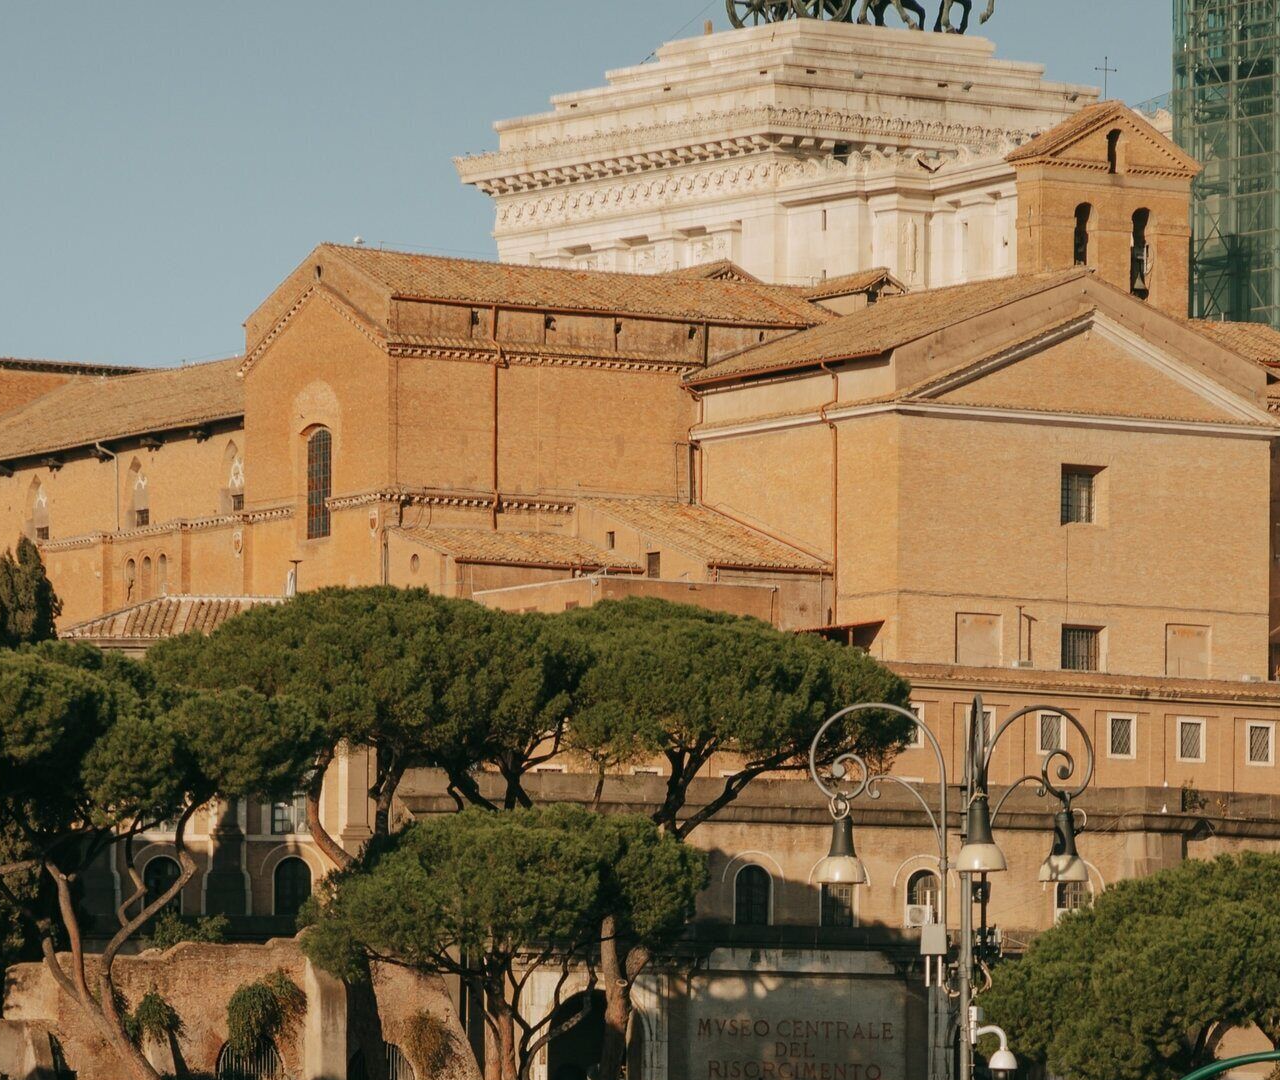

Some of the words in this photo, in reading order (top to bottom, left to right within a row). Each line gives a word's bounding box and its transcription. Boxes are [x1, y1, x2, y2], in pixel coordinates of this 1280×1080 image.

[697, 1018, 770, 1038] MVSEO
[776, 1018, 894, 1040] CENTRALE
[775, 1041, 815, 1058] DEL
[708, 1061, 881, 1080] RISORGIMENTO
